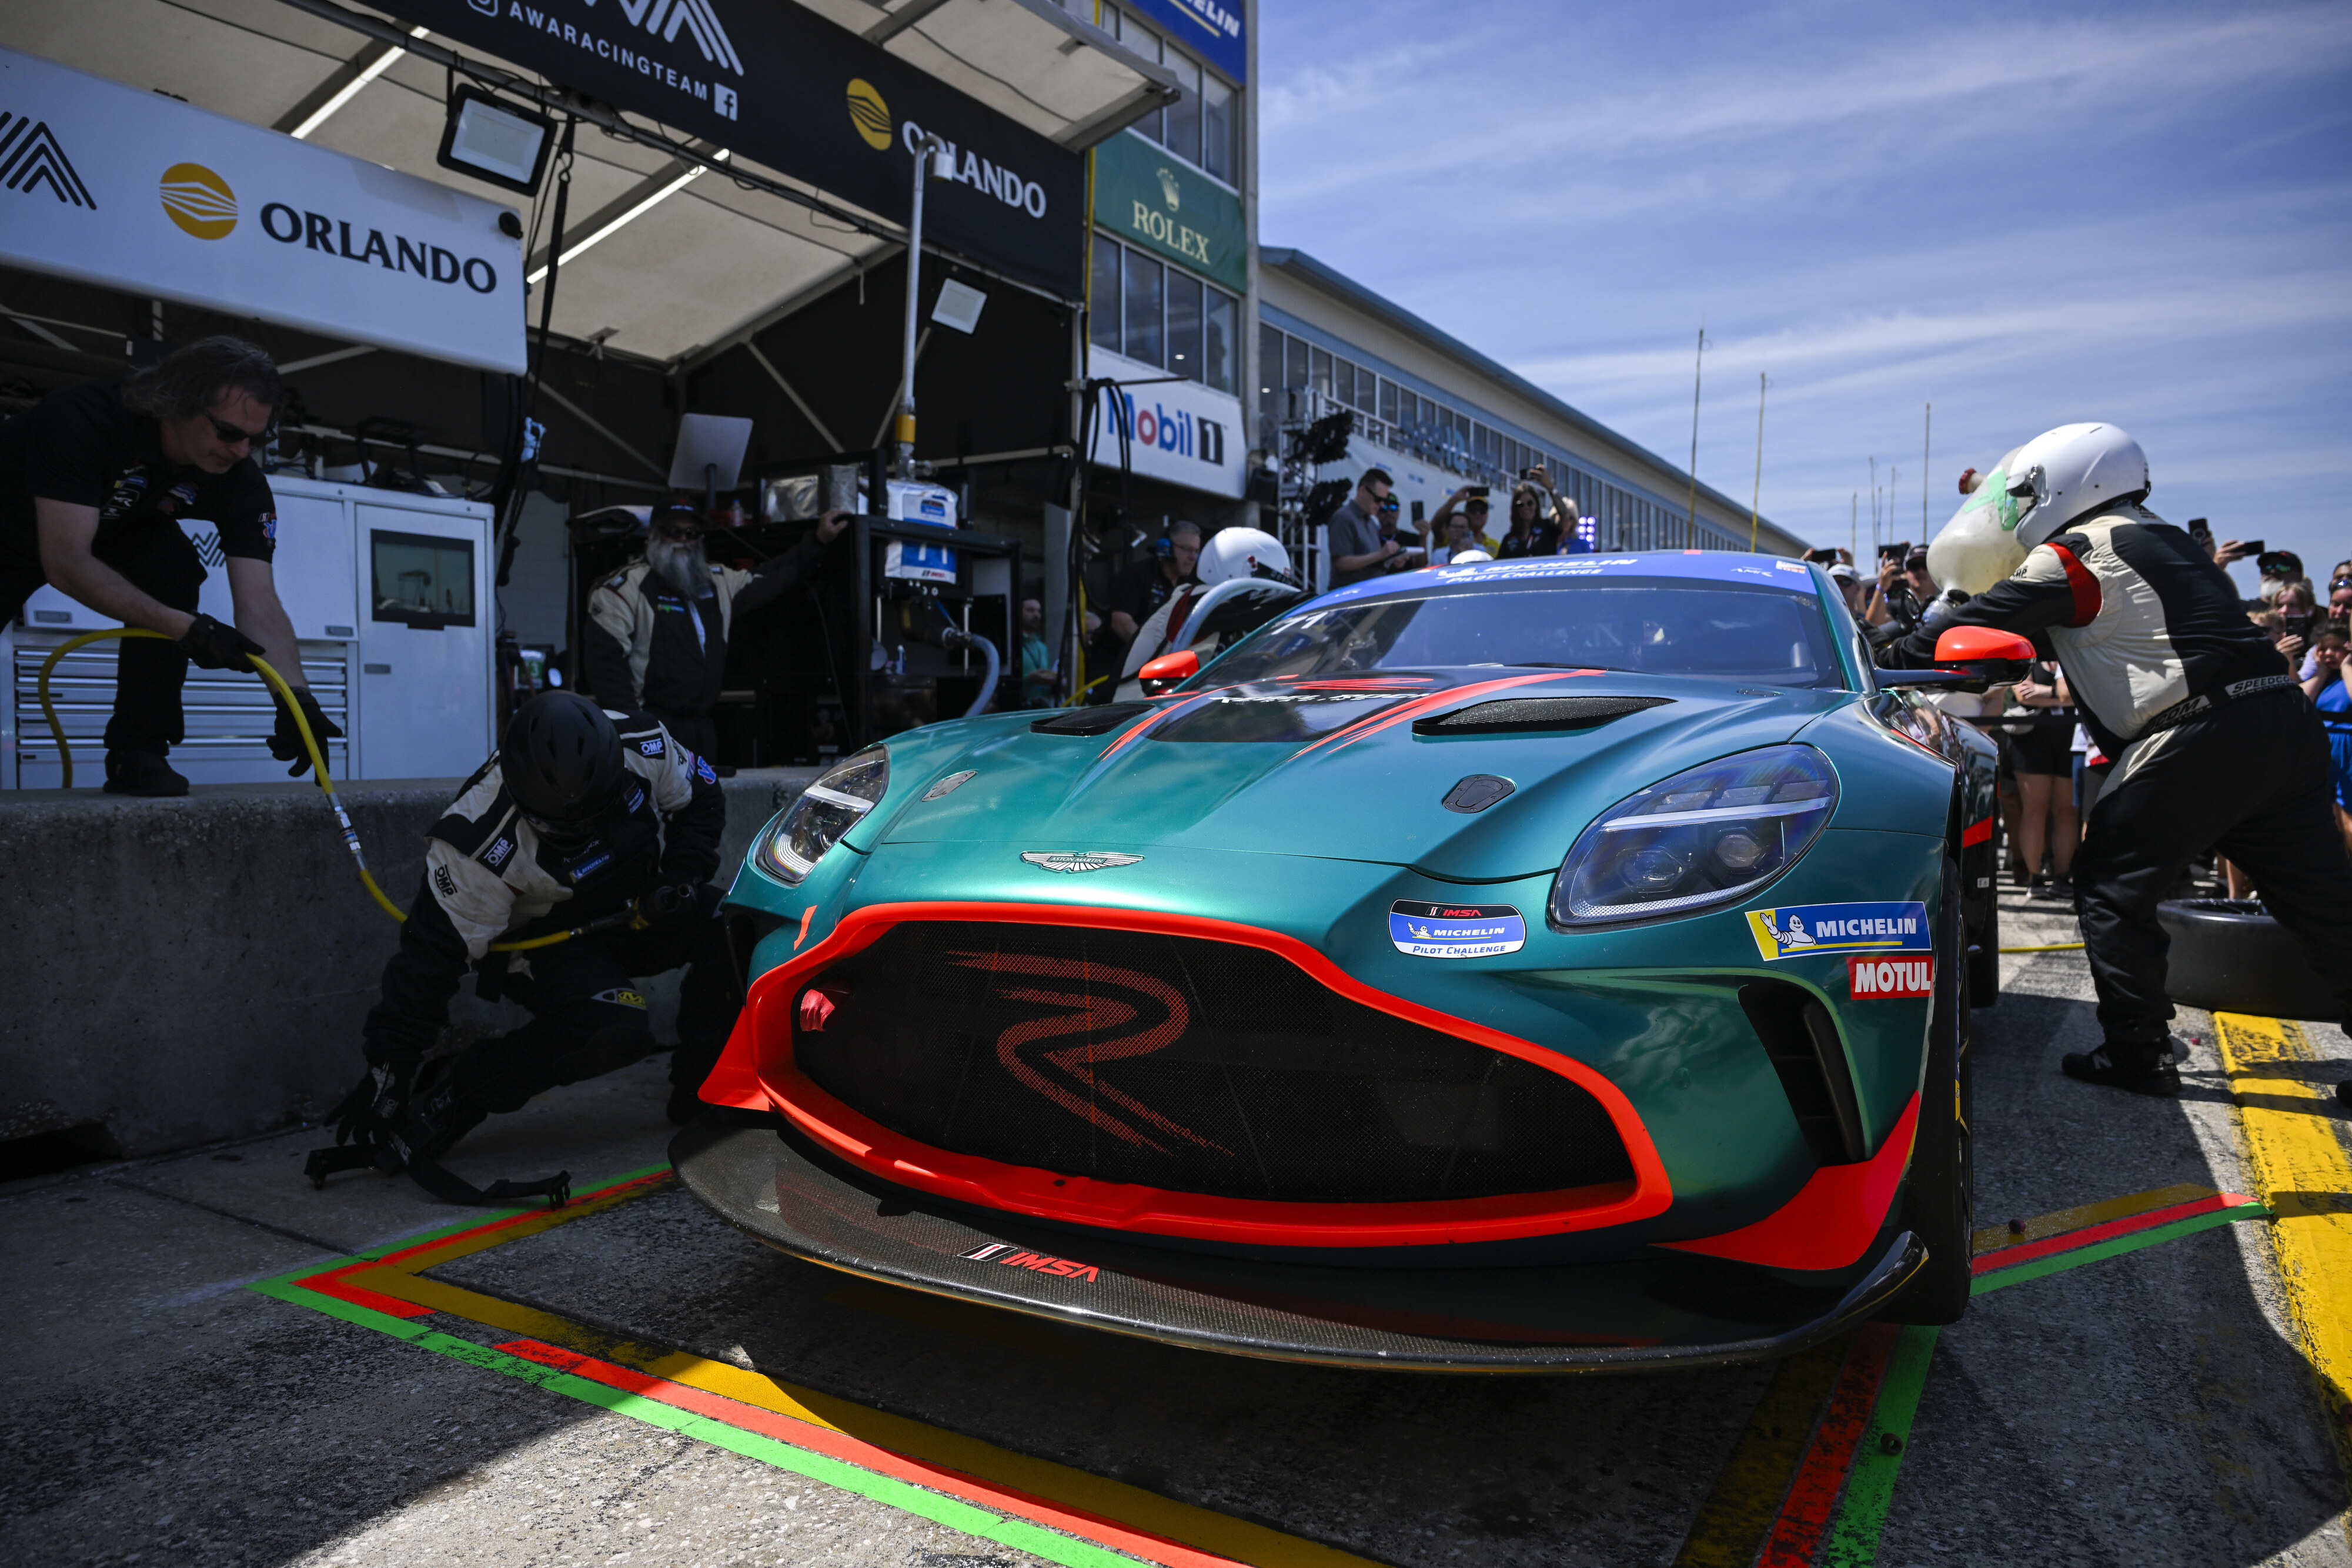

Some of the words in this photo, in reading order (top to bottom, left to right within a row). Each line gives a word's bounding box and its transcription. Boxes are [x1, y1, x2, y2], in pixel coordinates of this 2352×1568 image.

[1187, 0, 1240, 38] ELIN
[509, 1, 707, 101] AWARACINGTEAM
[1132, 200, 1210, 264] ROLEX
[260, 202, 497, 294] ORLANDO
[1106, 386, 1192, 458] Mobil
[1484, 559, 1638, 572] MICHELIN
[2232, 676, 2293, 694] SPEEDCO
[640, 741, 663, 753] OMP
[487, 838, 509, 864] OMP
[436, 866, 454, 895] OMP
[1434, 927, 1505, 936] MICHELIN
[1816, 918, 1916, 938] MICHELIN
[1412, 945, 1442, 954] PILOT
[1446, 945, 1506, 954] CHALLENGE
[1855, 962, 1931, 993] MOTUL
[999, 1252, 1099, 1283] IMSA
